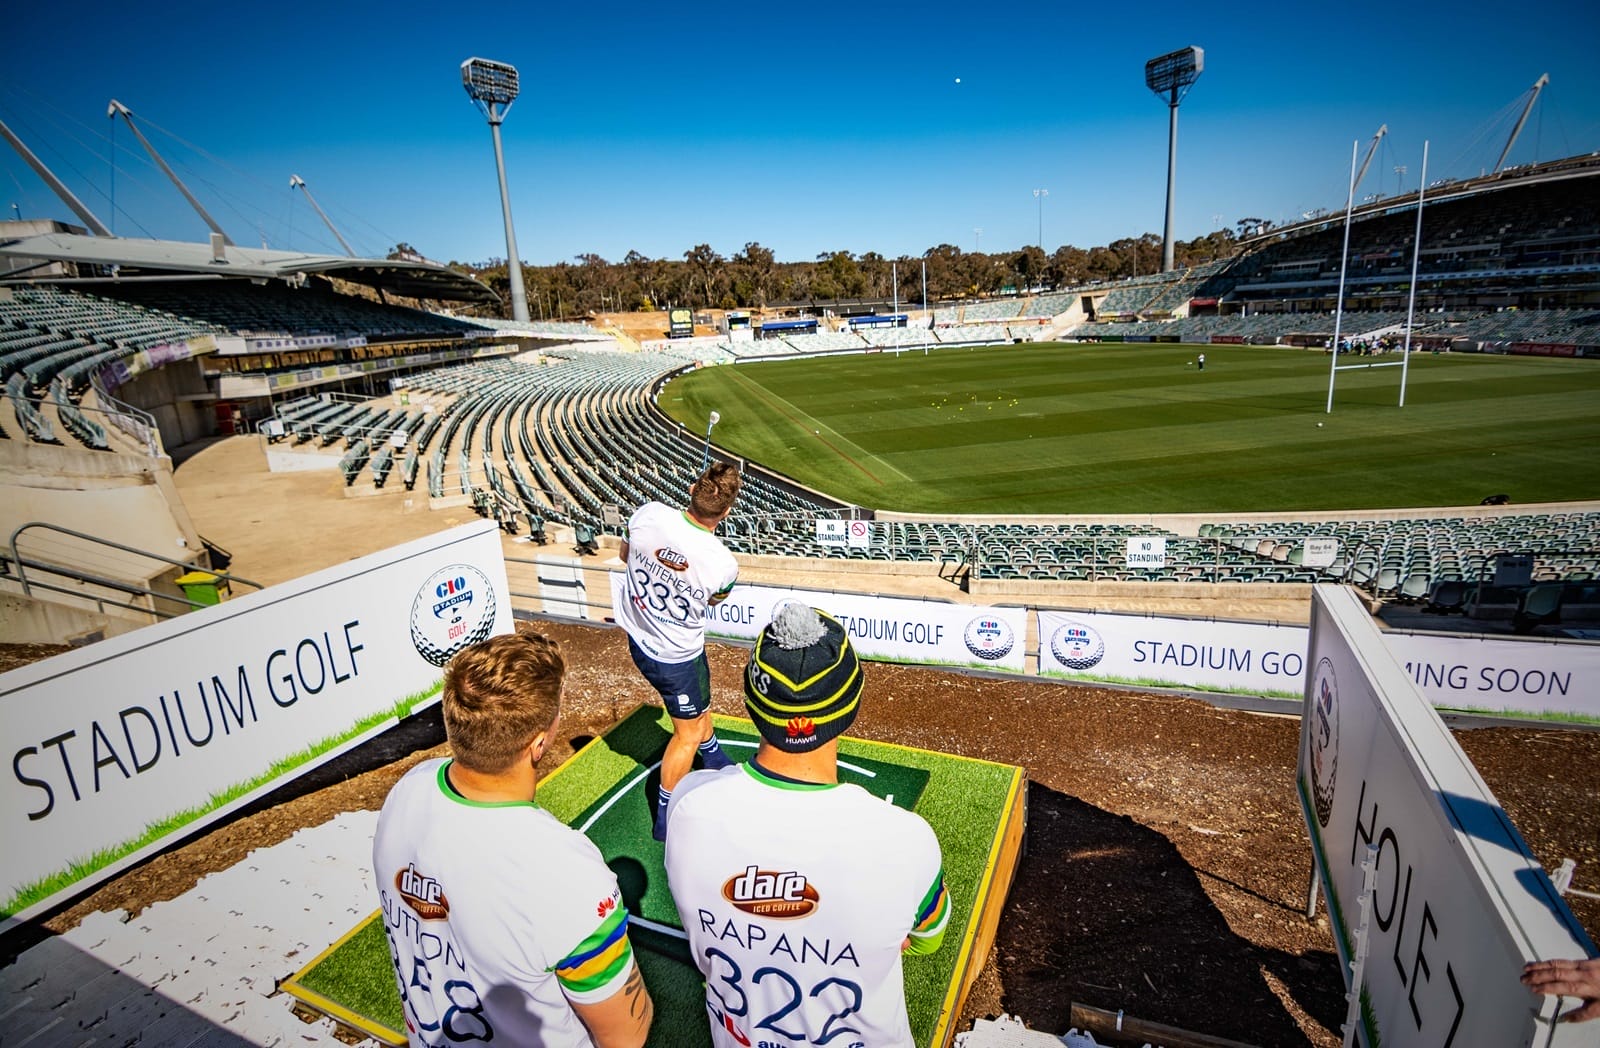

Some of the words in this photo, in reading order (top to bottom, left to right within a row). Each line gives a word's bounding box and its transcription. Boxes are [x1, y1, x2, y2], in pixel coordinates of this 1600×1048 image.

[826, 524, 835, 532] NO
[1128, 554, 1164, 563] STANDING
[1141, 542, 1152, 551] NO
[436, 576, 466, 599] GIO
[635, 549, 705, 602] WHITEHEAD
[433, 590, 474, 611] STADIUM
[634, 568, 691, 622] 333
[448, 621, 468, 640] GOLF
[720, 603, 755, 625] GOLF
[833, 614, 898, 641] TADIUM
[902, 621, 944, 645] GOLF
[1133, 640, 1252, 673] STADIUM
[1405, 661, 1469, 690] ING
[1476, 666, 1572, 696] SOON
[12, 664, 258, 822] STADIUM
[265, 619, 365, 709] GOLF
[785, 735, 818, 744] HUAWEI
[400, 862, 443, 906] dare
[733, 865, 807, 901] dare
[753, 904, 771, 913] ICED
[772, 903, 801, 912] COFFEE
[1351, 779, 1438, 1033] HOLE
[381, 889, 466, 972] SUTTON
[698, 909, 860, 968] RAPANA
[704, 946, 863, 1046] 322
